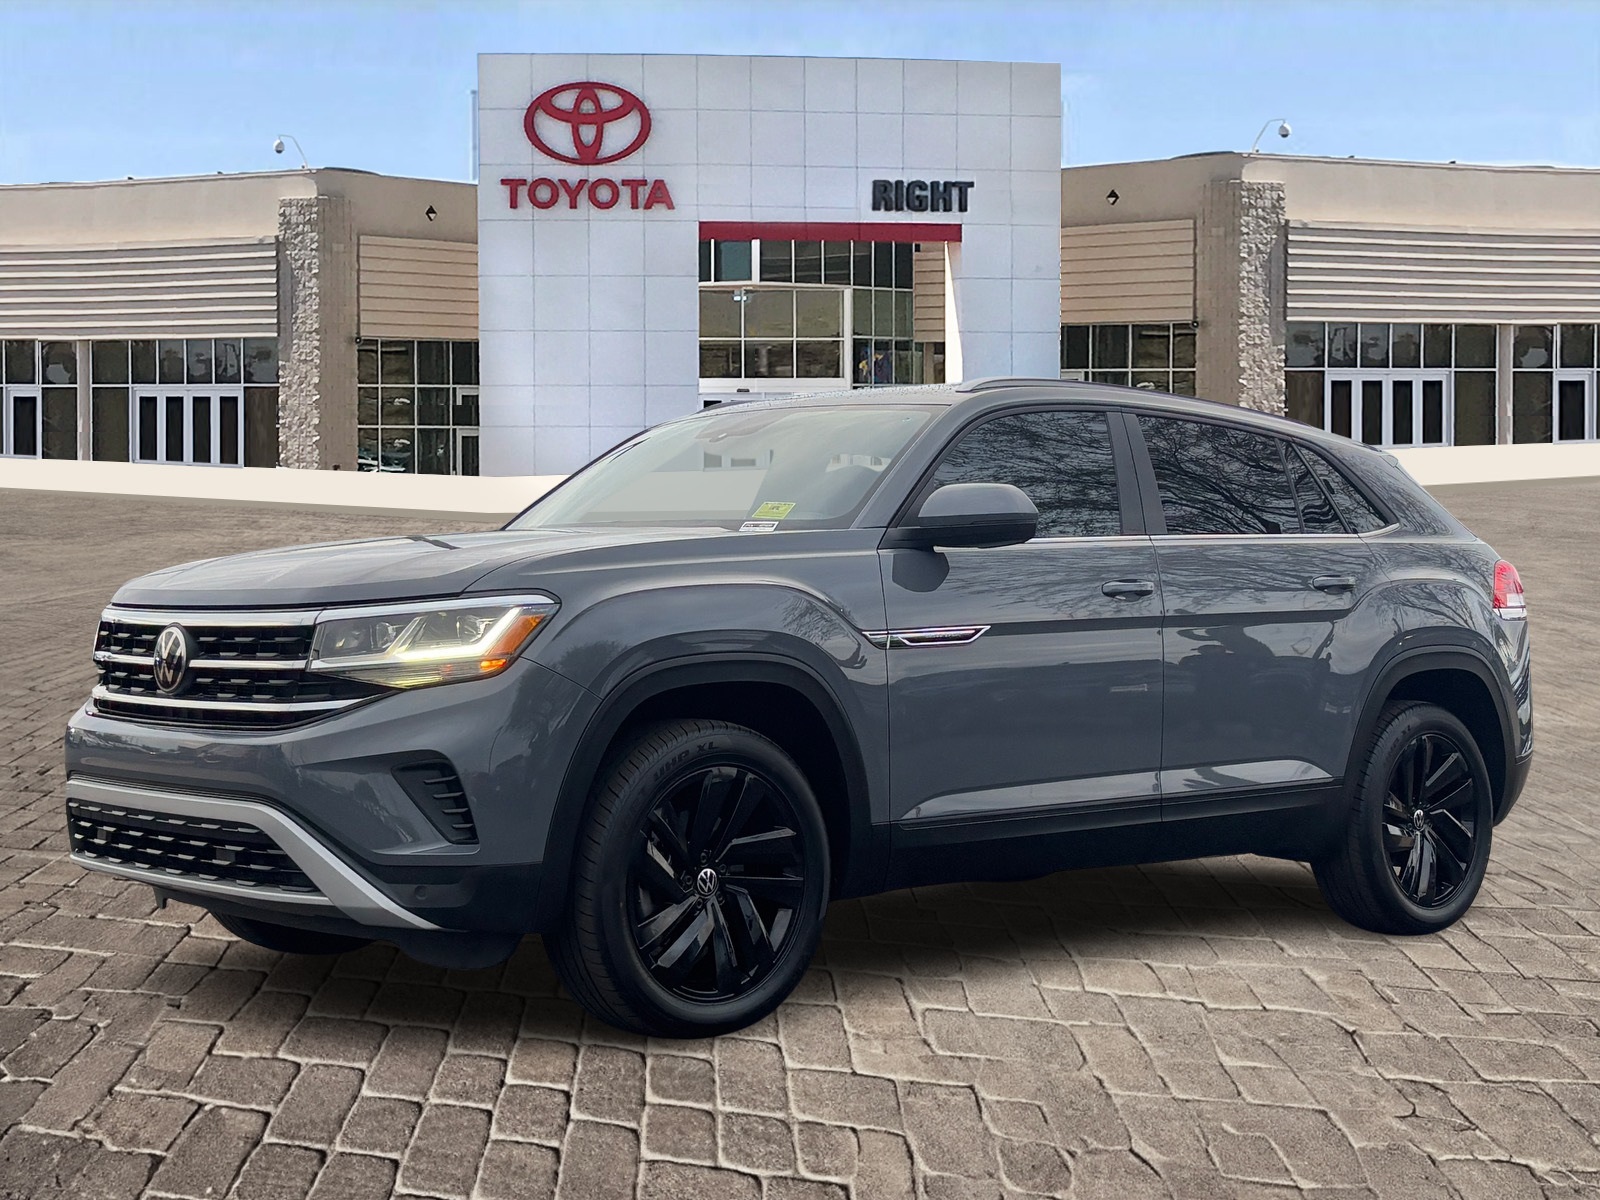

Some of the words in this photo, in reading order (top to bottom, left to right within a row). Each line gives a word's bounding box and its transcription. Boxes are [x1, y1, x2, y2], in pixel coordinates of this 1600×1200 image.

[500, 177, 675, 210] TOYOTA
[871, 179, 975, 212] RIGHT
[696, 741, 720, 754] XL
